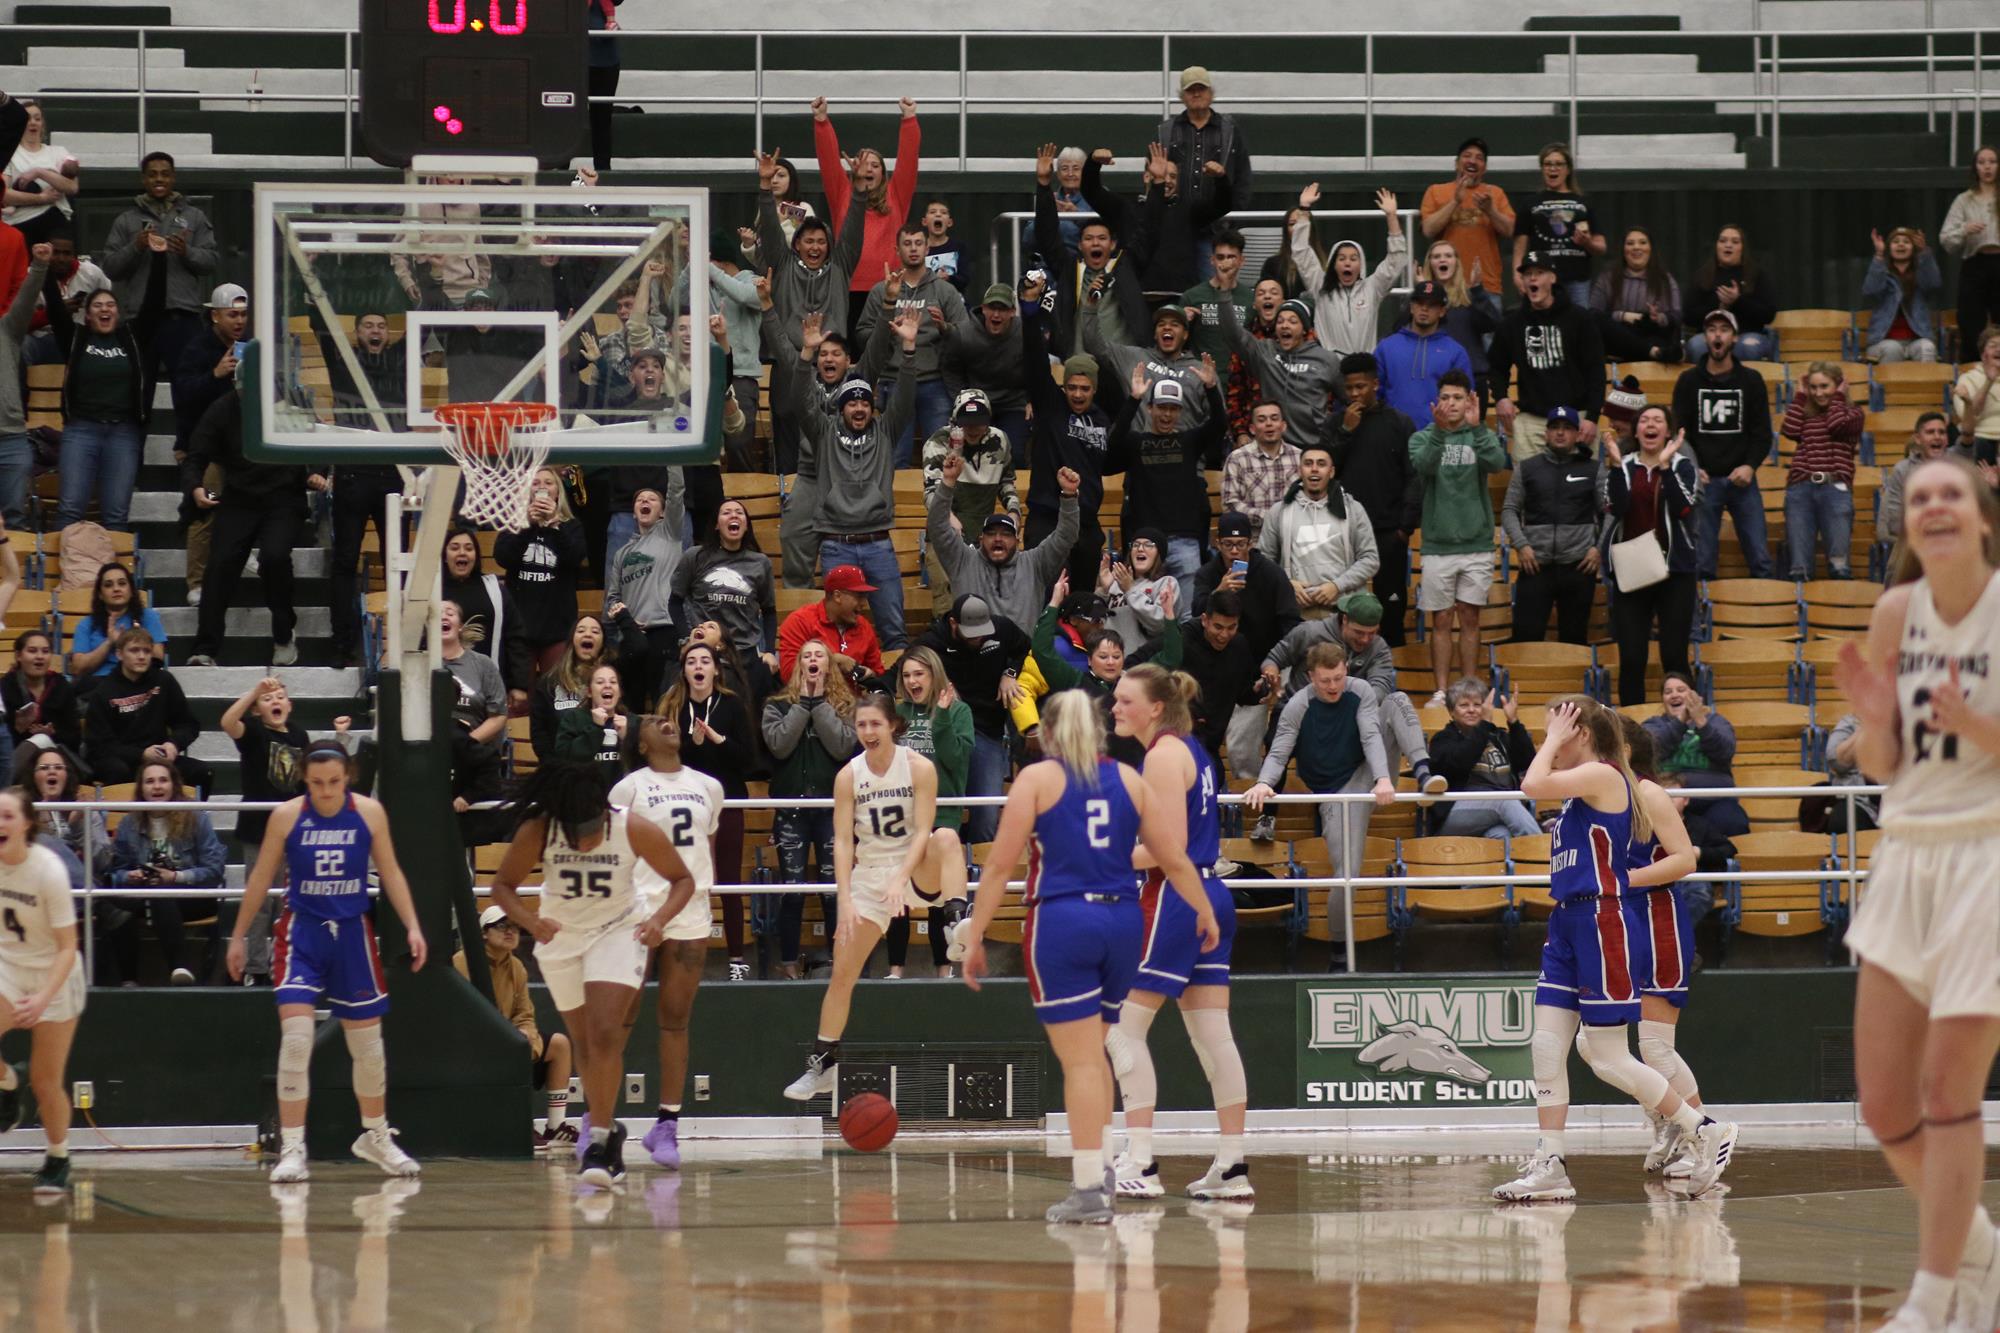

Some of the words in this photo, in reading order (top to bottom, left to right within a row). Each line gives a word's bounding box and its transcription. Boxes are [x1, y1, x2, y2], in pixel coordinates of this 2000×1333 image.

[895, 299, 926, 308] NMU
[518, 570, 556, 581] SFTBA
[707, 592, 747, 605] SOFTBALL
[648, 793, 706, 807] GREYHOUNDS
[671, 807, 694, 846] 2
[869, 805, 907, 837] 12
[1086, 799, 1110, 848] 2
[315, 850, 345, 876] 22
[553, 853, 619, 866] GREYHOUNDS
[560, 869, 612, 899] 35
[3, 906, 26, 942] 4
[1307, 987, 1537, 1048] ENMU
[1306, 1080, 1425, 1102] STUDENT
[1436, 1079, 1537, 1101] SECTION
